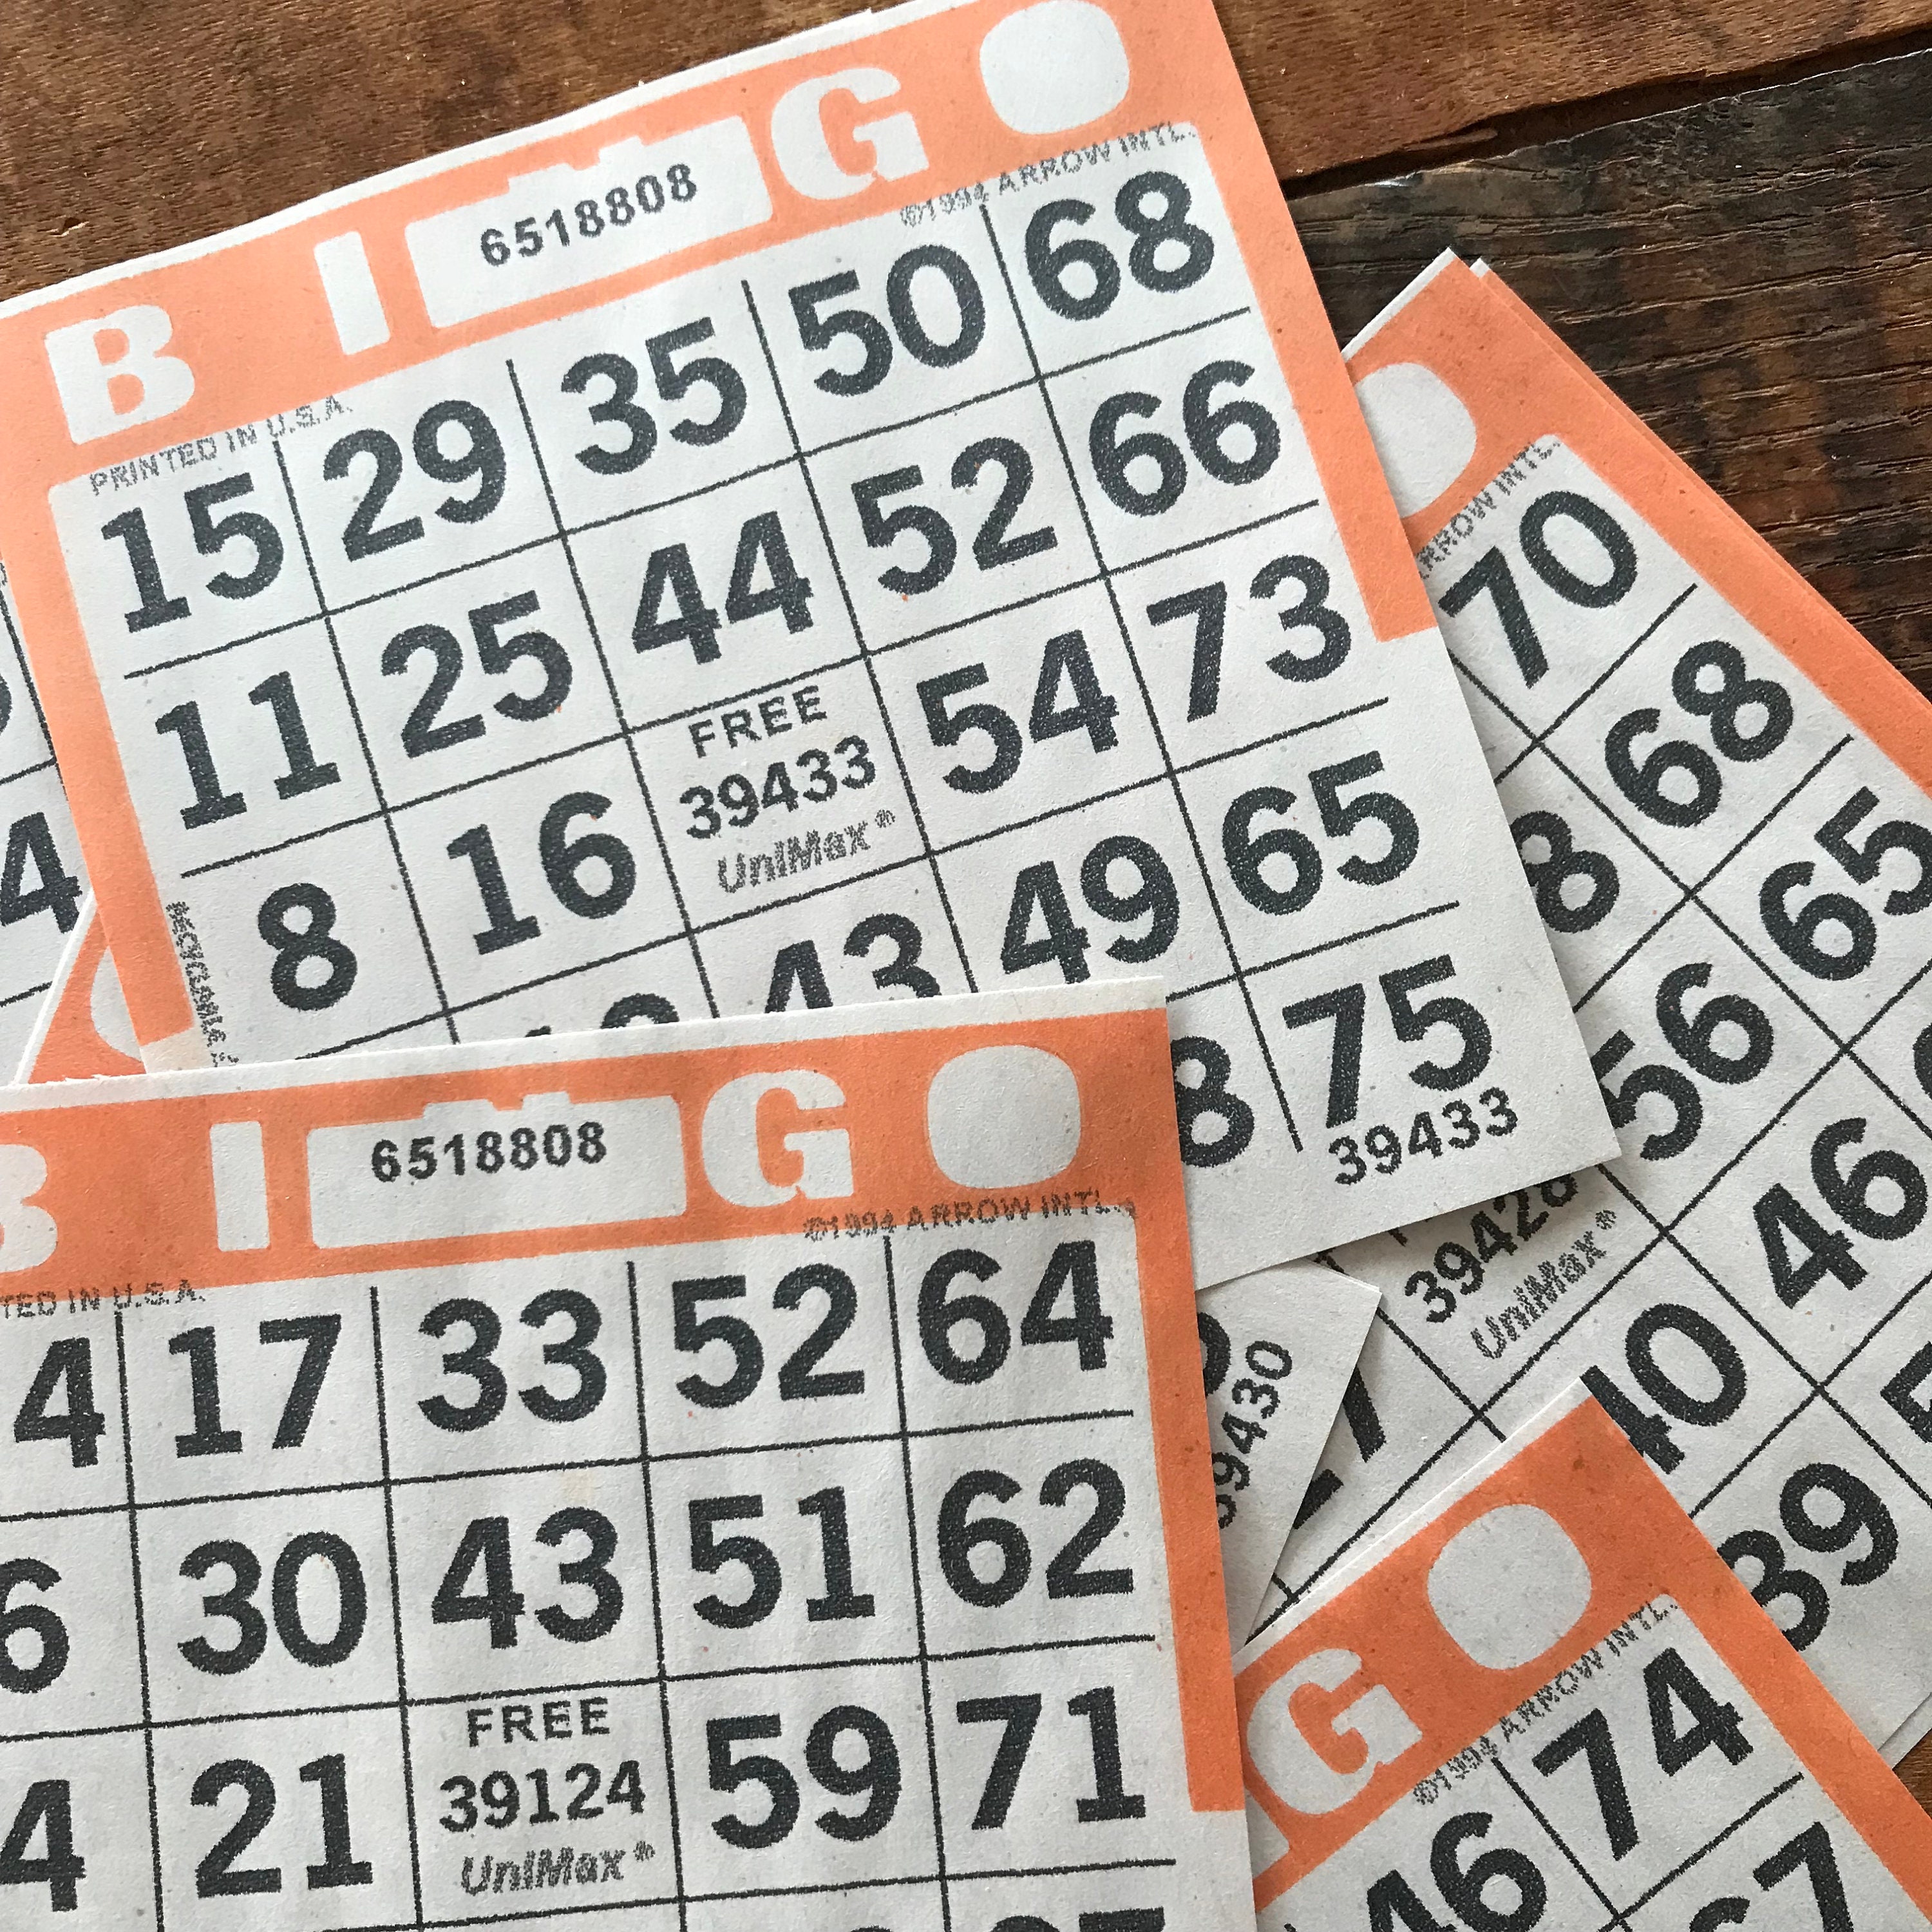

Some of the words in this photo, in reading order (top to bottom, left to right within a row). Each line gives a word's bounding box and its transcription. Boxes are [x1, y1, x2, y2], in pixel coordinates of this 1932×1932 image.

[481, 165, 696, 265] 6518808
[999, 140, 1110, 194] ARROW
[1025, 171, 1214, 320] 68
[788, 245, 985, 396] 50
[90, 437, 218, 496] PRINTED
[225, 424, 257, 452] IN
[267, 394, 354, 438] U.S.A.
[562, 317, 746, 474] 35
[1089, 361, 1280, 517] 66
[101, 473, 283, 632] 15
[324, 401, 506, 562] 29
[851, 437, 1057, 594] 52
[1417, 488, 1497, 578] RROW
[632, 511, 813, 665] 44
[1146, 554, 1351, 722] 73
[1437, 491, 1638, 689] 70
[382, 591, 572, 758] 25
[688, 686, 827, 758] FREE
[916, 630, 1119, 794] 54
[1605, 640, 1794, 828] 68
[155, 672, 341, 829] 11
[680, 735, 875, 838] 39433
[0, 812, 82, 933] 4
[447, 792, 636, 955] 16
[1222, 751, 1419, 916] 65
[1759, 786, 1932, 981] 65
[258, 883, 357, 1012] 8
[1000, 836, 1180, 984] 49
[1282, 954, 1492, 1128] 75
[1590, 962, 1774, 1161] 56
[372, 1122, 606, 1182] 6518808
[1329, 1087, 1518, 1185] 39433
[907, 1197, 1031, 1231] ARROW
[1753, 1117, 1928, 1309] 46
[68, 1287, 100, 1314] IN
[418, 1289, 607, 1433] 33
[672, 1264, 864, 1408] 52
[916, 1240, 1114, 1385] 64
[14, 1338, 106, 1468] 4
[169, 1314, 341, 1458] 17
[178, 1531, 368, 1676] 30
[431, 1506, 623, 1649] 43
[688, 1486, 875, 1629] 51
[937, 1458, 1133, 1608] 62
[1717, 1463, 1899, 1652] 39
[0, 1557, 70, 1694] 6
[1499, 1648, 1603, 1743] ARROW
[467, 1697, 610, 1747] FREE
[706, 1705, 902, 1849] 59
[956, 1686, 1146, 1830] 71
[1532, 1647, 1753, 1861] 74
[0, 1780, 86, 1911] 4
[191, 1754, 373, 1899] 21
[440, 1760, 645, 1832] 39124
[1689, 1822, 1854, 1932] 7
